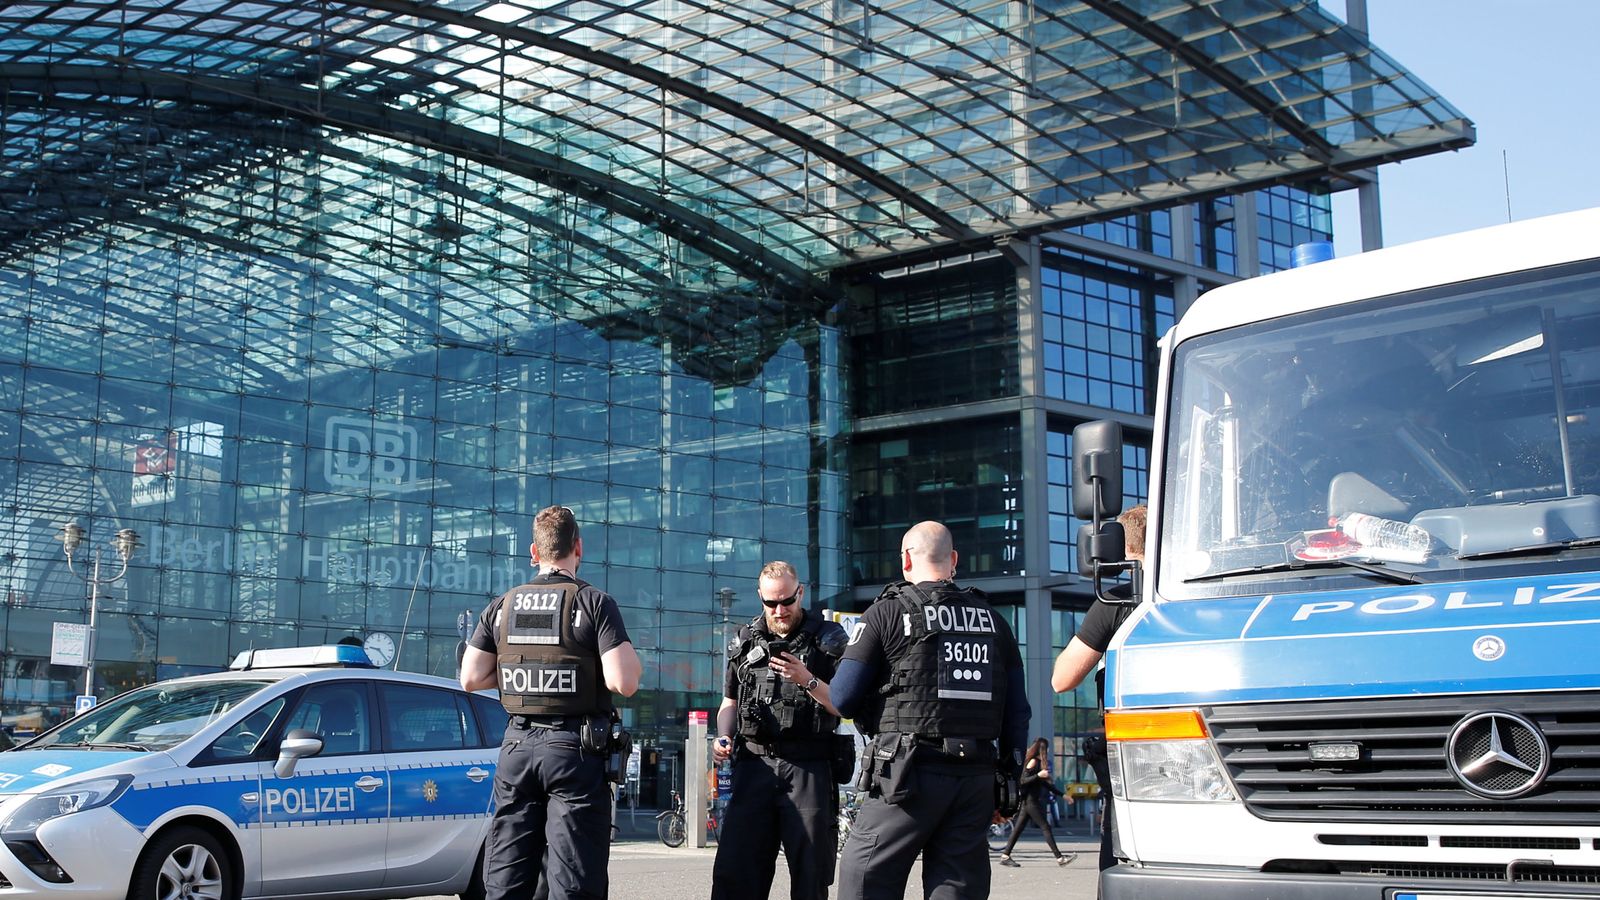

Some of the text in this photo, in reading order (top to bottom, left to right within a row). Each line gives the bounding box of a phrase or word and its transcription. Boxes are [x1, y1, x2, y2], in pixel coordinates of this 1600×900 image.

[336, 427, 406, 481] DB
[302, 539, 527, 592] Hauptbahnh
[513, 593, 559, 611] 36112
[923, 605, 996, 633] POLIZEI
[944, 641, 989, 664] 36101
[501, 667, 577, 693] POLIZEI
[265, 786, 355, 815] POLIZEI
